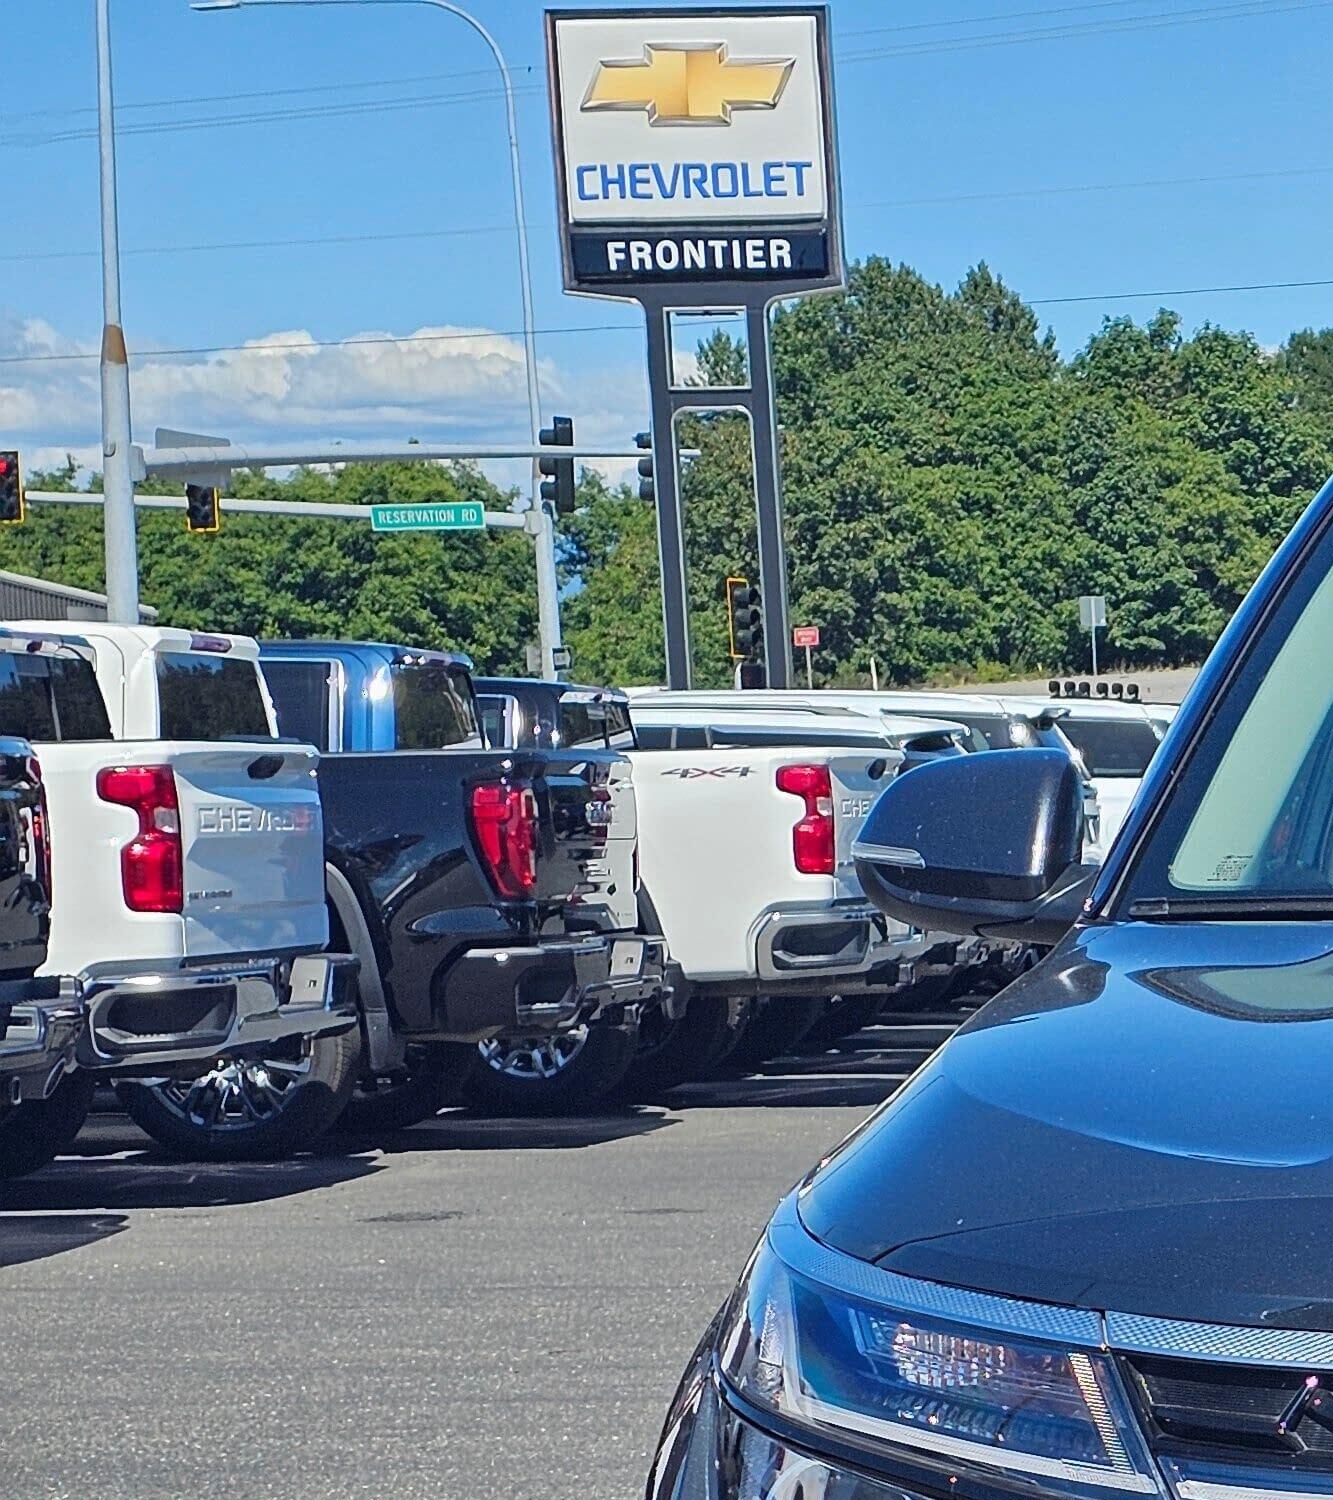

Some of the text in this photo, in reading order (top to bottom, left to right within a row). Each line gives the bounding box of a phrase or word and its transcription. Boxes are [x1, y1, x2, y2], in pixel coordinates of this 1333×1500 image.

[576, 161, 813, 200] CHEVROLET
[606, 238, 792, 271] FRONTIER
[377, 508, 477, 524] RESERVATION RD
